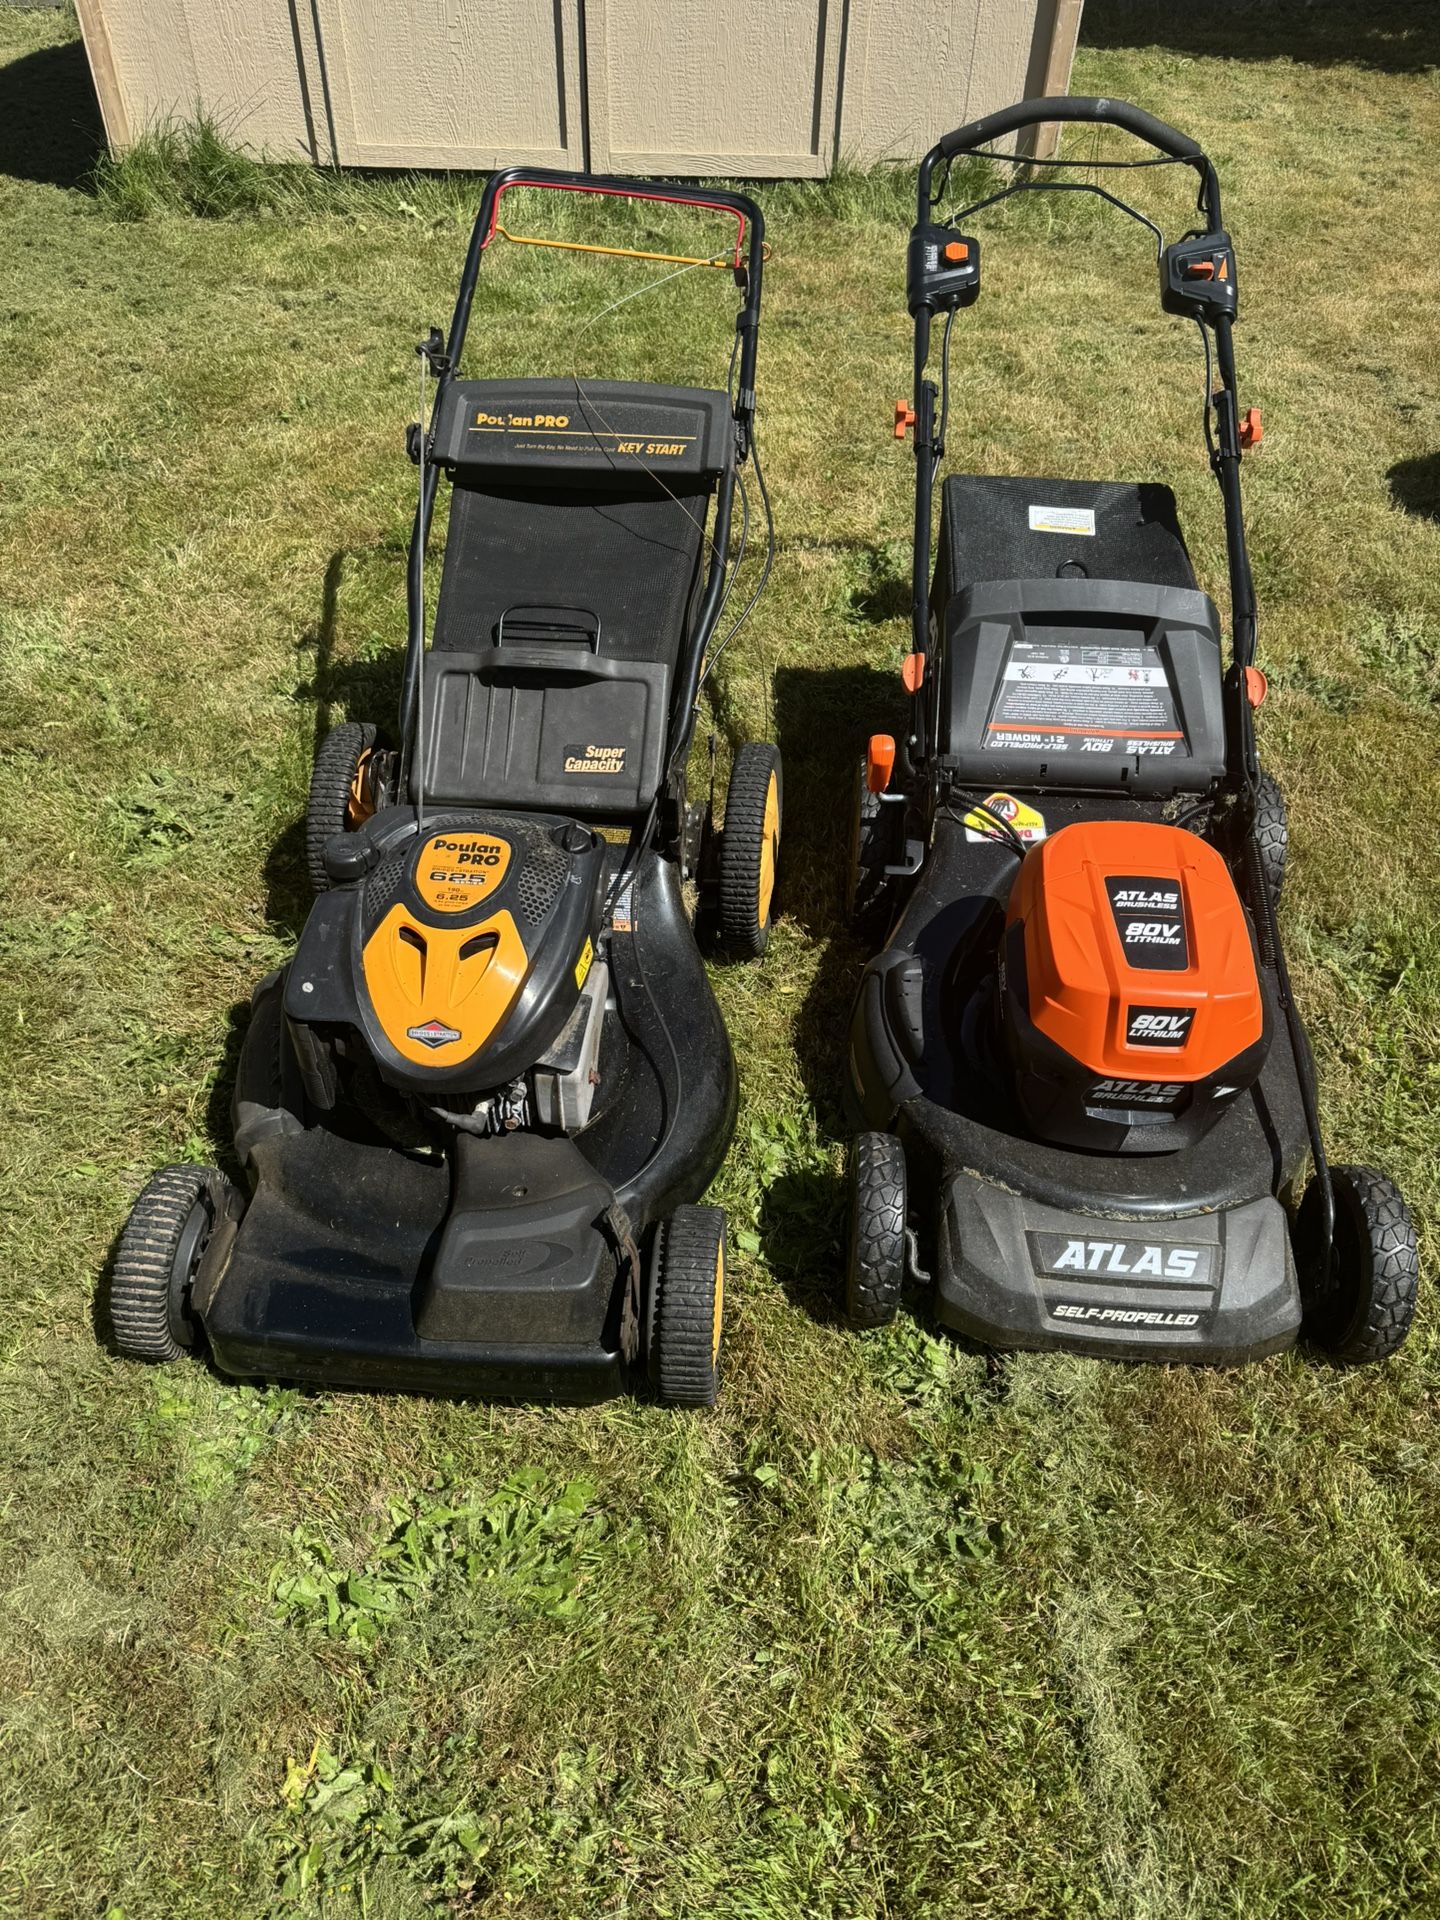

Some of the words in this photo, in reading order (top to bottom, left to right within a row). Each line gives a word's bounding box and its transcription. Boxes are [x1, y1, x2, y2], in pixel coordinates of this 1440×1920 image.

[534, 414, 569, 428] PRO
[617, 442, 645, 454] KEY
[645, 443, 687, 456] START
[996, 732, 1041, 743] MOWER
[990, 740, 1069, 751] SELF-PROPELLED
[1080, 742, 1113, 753] 80V
[1125, 745, 1175, 755] ATLAS
[585, 745, 626, 760] Super
[564, 757, 624, 773] Capacity
[433, 839, 501, 854] Poulan
[457, 853, 500, 866] PRO
[429, 871, 486, 883] 625
[436, 893, 468, 901] 6.25
[1113, 890, 1179, 903] ATLAS
[1115, 901, 1178, 910] BRUSHLESS
[1125, 922, 1181, 937] 80V
[1125, 935, 1181, 945] LITHIUM
[1131, 1015, 1191, 1031] 80V
[1128, 1029, 1185, 1039] LITHIUM
[1092, 1080, 1185, 1096] ATLAS
[1091, 1092, 1177, 1104] BRUSHLESS
[1052, 1241, 1200, 1278] ATLAS
[1053, 1305, 1200, 1326] SELF-PROPELLED
